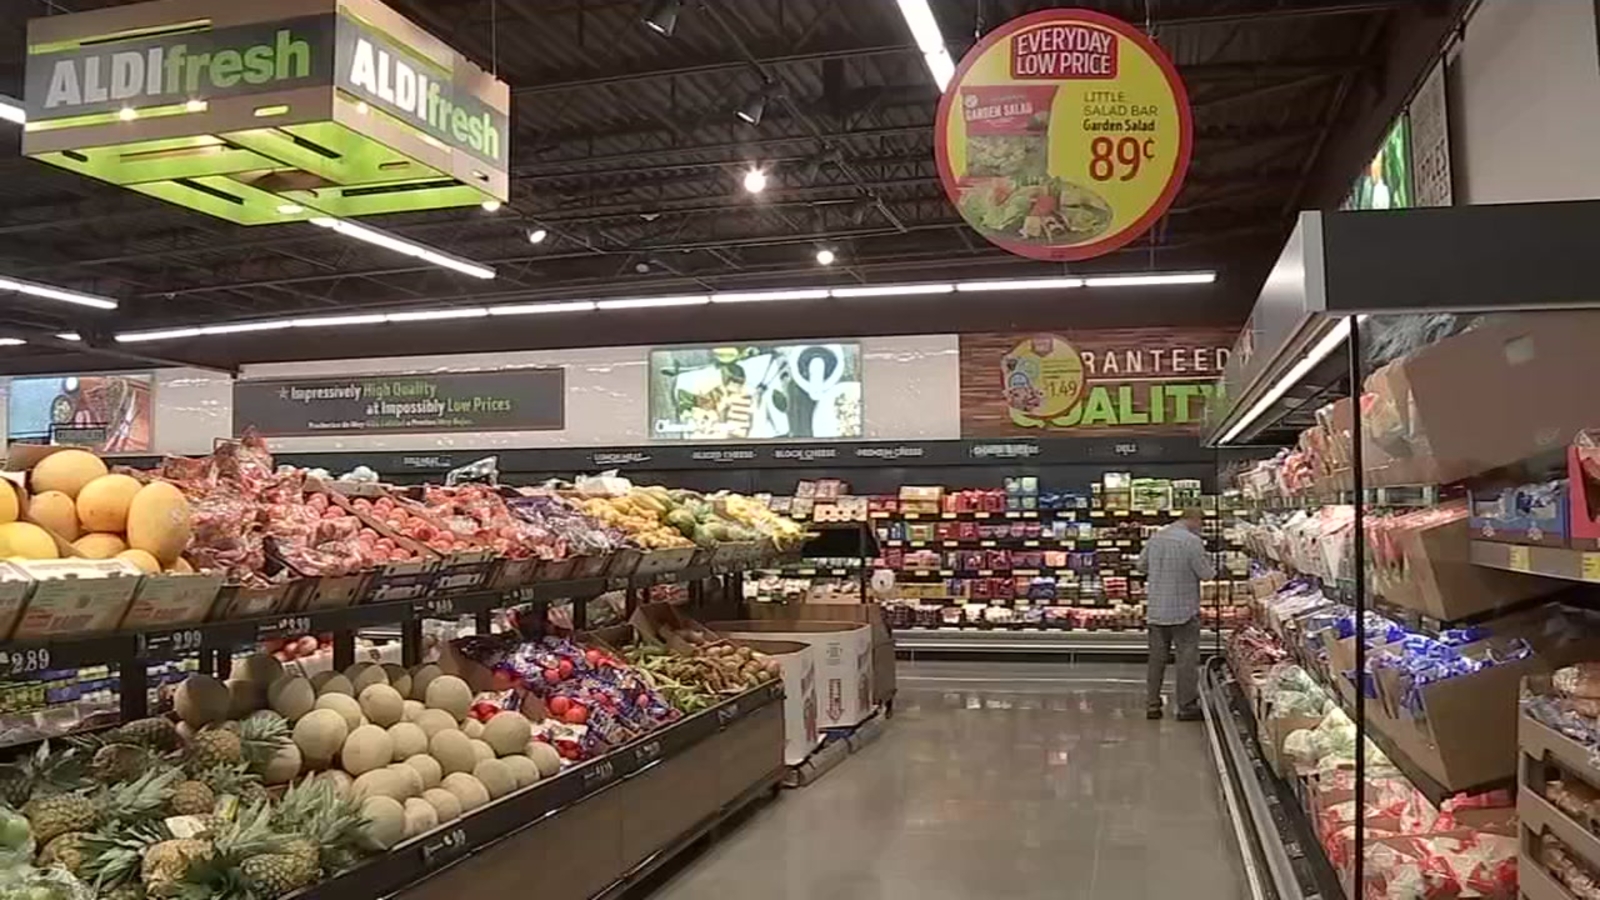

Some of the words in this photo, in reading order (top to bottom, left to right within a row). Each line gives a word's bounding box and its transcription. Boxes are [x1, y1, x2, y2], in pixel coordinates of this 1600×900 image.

[1017, 27, 1111, 55] EVERYDAY
[1017, 53, 1057, 75] LOW
[1060, 52, 1111, 75] PRICE
[1084, 91, 1126, 102] LITTLE
[1083, 105, 1128, 116] SALAD
[1131, 105, 1158, 116] BAR
[1083, 118, 1122, 131] Garden
[1124, 119, 1155, 131] Salad
[1089, 136, 1155, 182] 89¢
[290, 384, 362, 404] Impressively
[363, 383, 391, 400] High
[393, 380, 437, 398] Quality
[366, 402, 379, 415] at
[381, 399, 445, 418] Impossibly
[447, 398, 471, 412] Low
[473, 397, 511, 411] Prices
